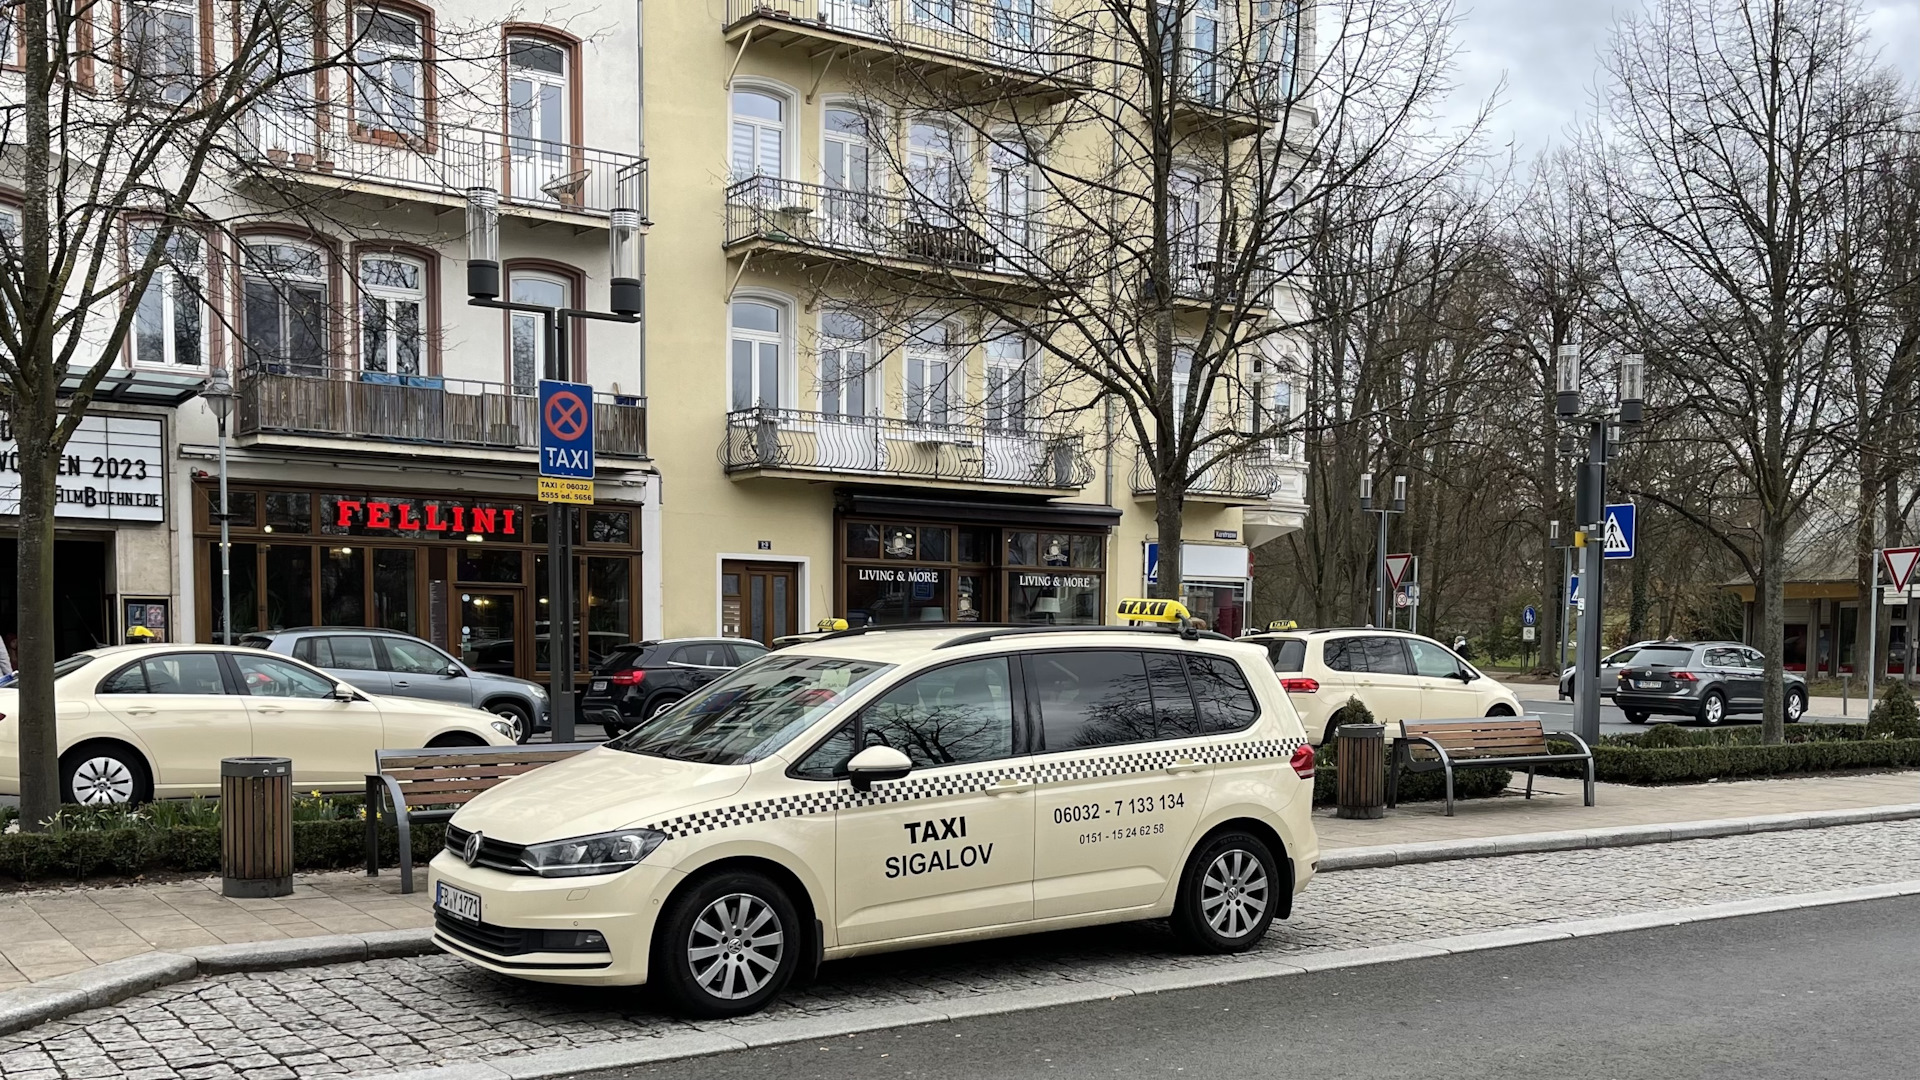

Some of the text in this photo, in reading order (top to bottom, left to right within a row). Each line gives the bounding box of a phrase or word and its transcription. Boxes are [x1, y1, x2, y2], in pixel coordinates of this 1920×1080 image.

[92, 456, 147, 480] 2023
[545, 447, 588, 470] TAXI
[337, 501, 515, 534] FELLINI
[859, 569, 939, 583] LIVING & MORE
[1019, 575, 1090, 588] LIVING & MORE
[1125, 601, 1161, 615] TAXI
[1054, 803, 1100, 824] 06032
[1114, 800, 1123, 816] 7
[1128, 796, 1154, 814] 133
[1159, 792, 1184, 810] 134
[904, 816, 966, 844] TAXI
[1079, 832, 1102, 844] 0151
[1112, 829, 1123, 840] 15
[1125, 827, 1137, 838] 24
[1140, 825, 1151, 836] 62
[1153, 823, 1164, 834] 58
[885, 843, 993, 878] SIGALOV
[459, 894, 479, 918] 1771
